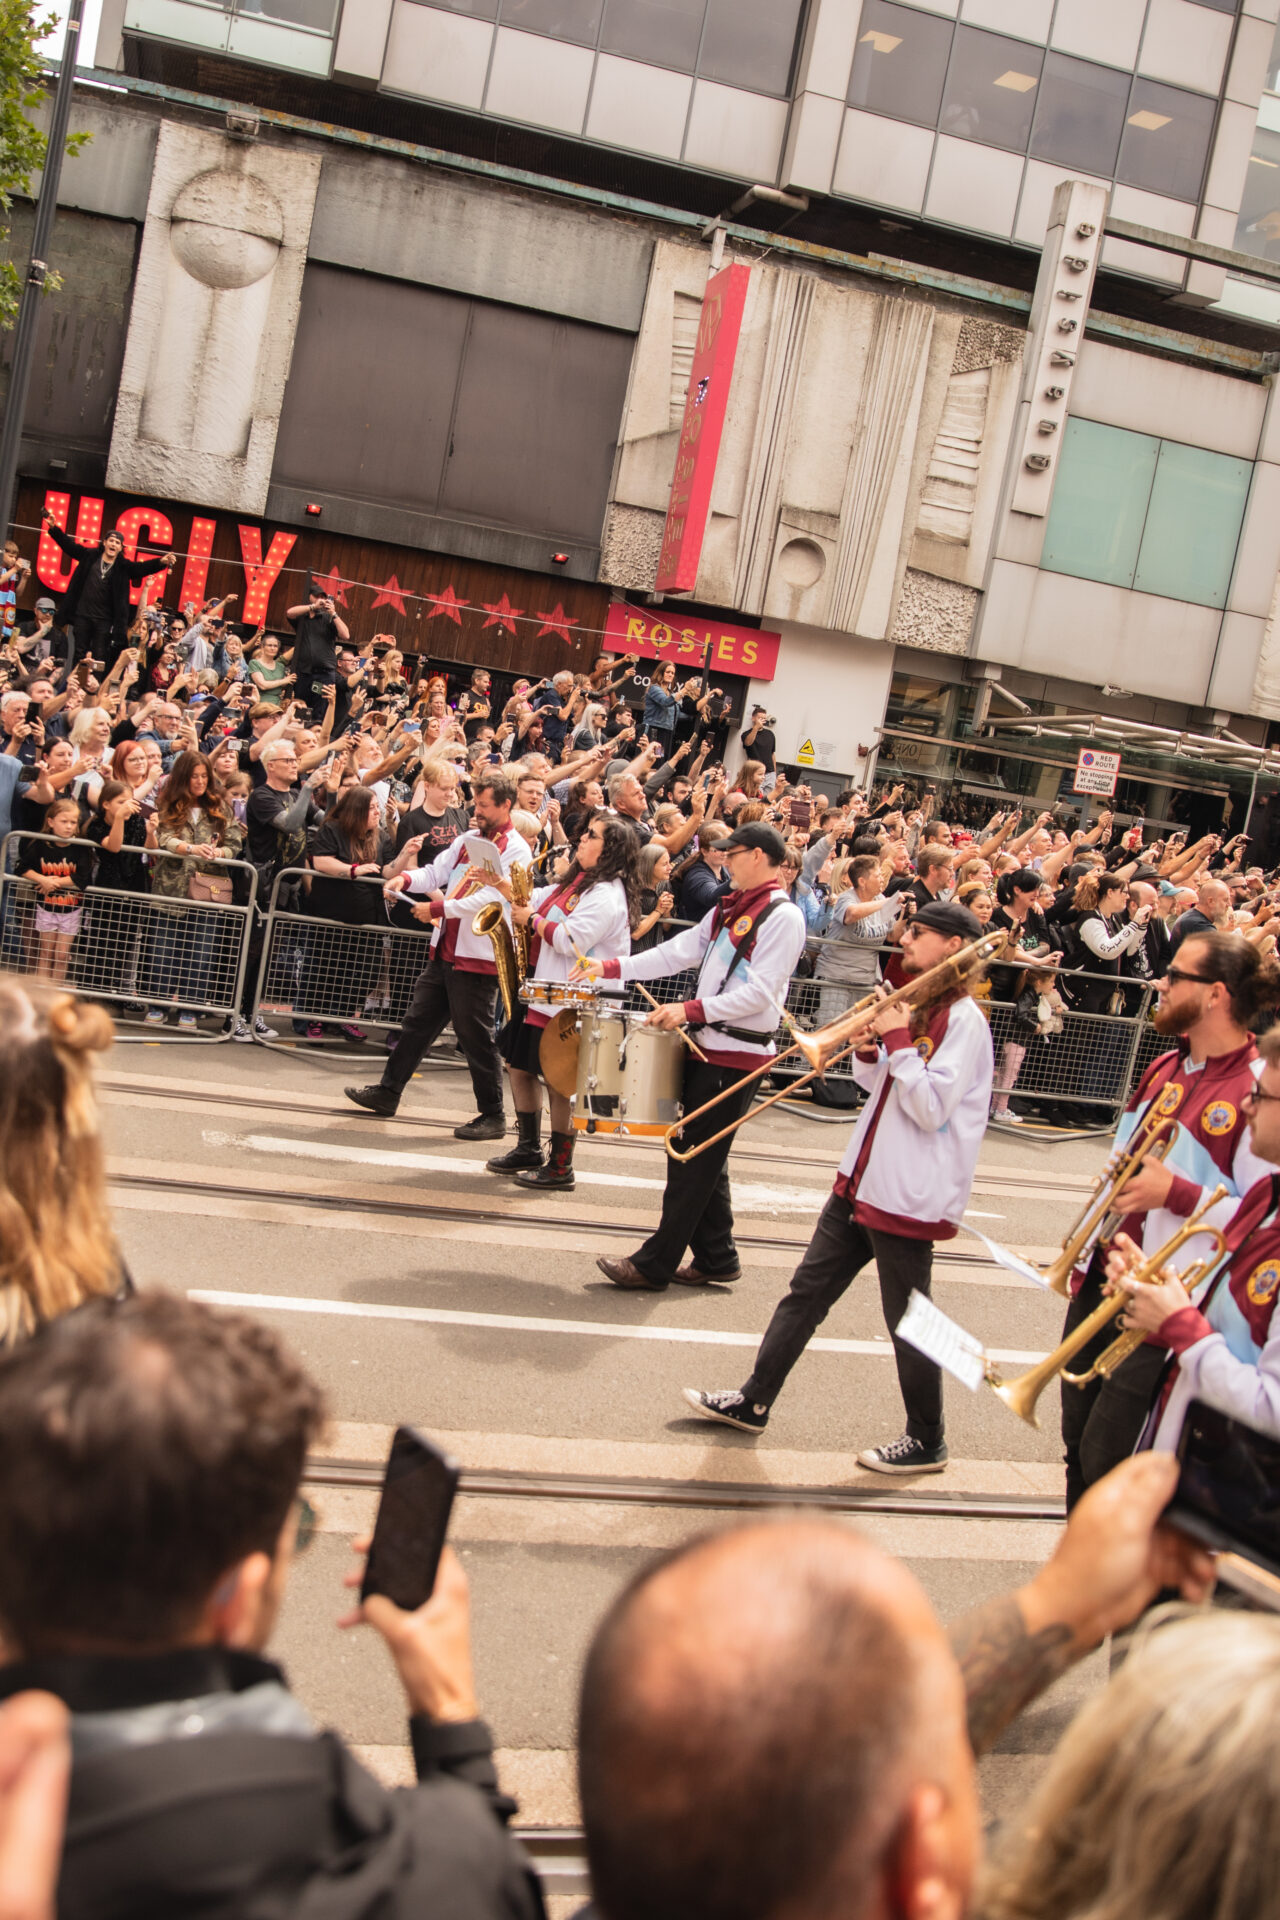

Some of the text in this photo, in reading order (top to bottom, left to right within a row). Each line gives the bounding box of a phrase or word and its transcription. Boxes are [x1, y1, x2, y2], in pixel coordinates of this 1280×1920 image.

[1025, 221, 1096, 471] Quayside
[37, 490, 298, 626] UGLY
[626, 617, 759, 665] ROSIES
[1090, 772, 1113, 781] stopping
[1095, 761, 1115, 769] ROUTE
